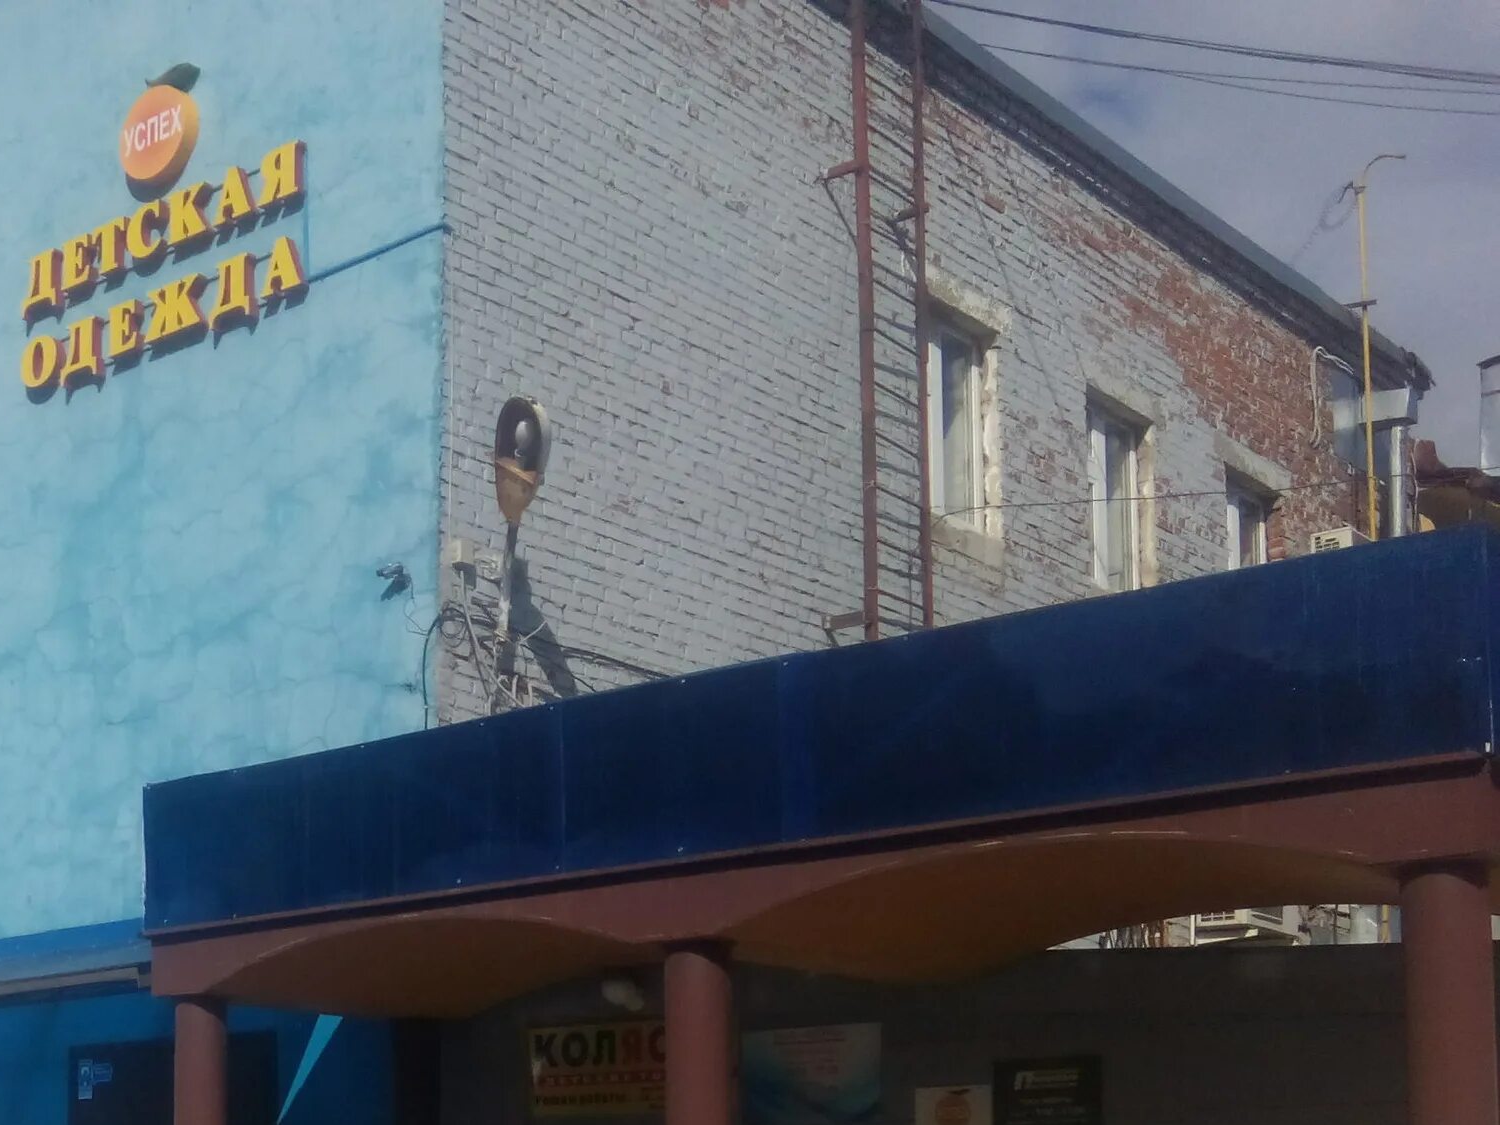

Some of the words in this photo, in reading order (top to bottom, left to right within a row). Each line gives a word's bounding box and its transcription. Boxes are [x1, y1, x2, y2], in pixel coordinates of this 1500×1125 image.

[124, 104, 183, 157] УСПЕХ
[21, 139, 306, 321] ДЕТСКАЯ
[20, 236, 308, 390] ОДЕЖДА
[534, 1025, 665, 1067] КОЛЯС
